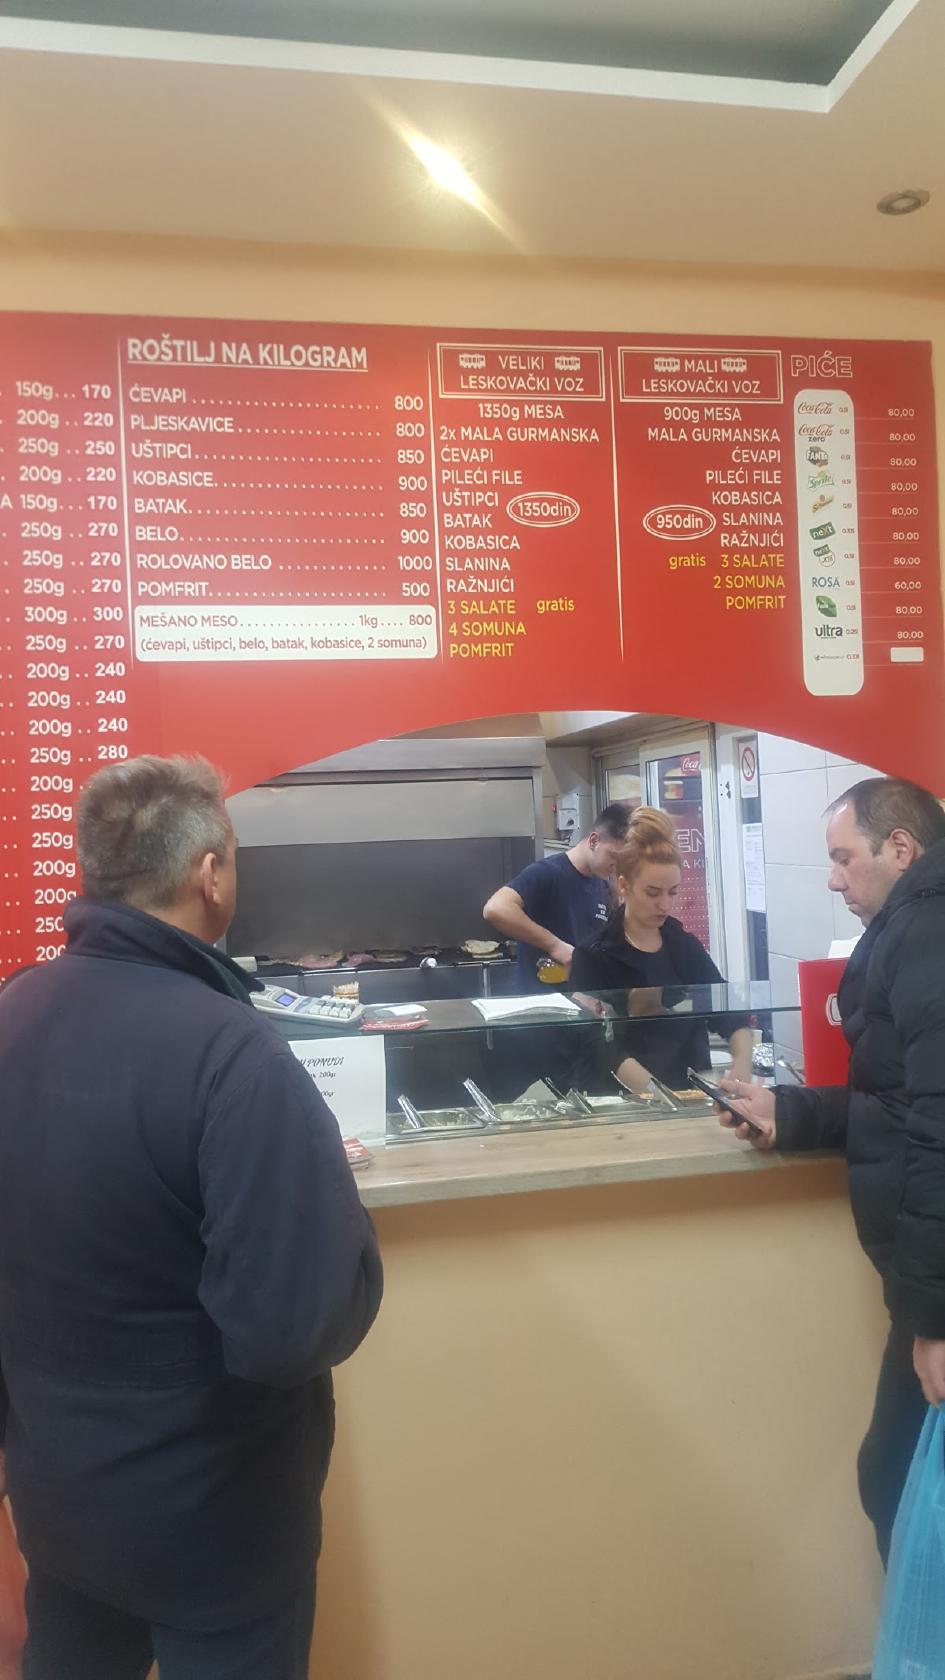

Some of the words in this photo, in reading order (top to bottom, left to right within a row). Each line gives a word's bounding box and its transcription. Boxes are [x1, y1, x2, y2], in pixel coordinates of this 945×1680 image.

[127, 333, 215, 364] ROŠTILJ
[222, 343, 253, 365] NA
[259, 345, 368, 369] KILOGRAM
[499, 355, 545, 370] VELIKI
[684, 359, 718, 373] MALI
[790, 350, 853, 378] PIĆE
[15, 381, 54, 401] 150g
[81, 385, 111, 400] 170
[460, 373, 550, 391] LESKOVAČKI
[555, 378, 584, 391] VOZ
[642, 376, 728, 393] LESKOVAČKI
[732, 380, 761, 394] VOZ
[129, 383, 187, 404] ĆEVAPI
[394, 395, 424, 411] 800
[17, 409, 59, 429] 200g
[83, 412, 114, 427] 220
[478, 403, 520, 421] 1350g
[524, 404, 565, 419] MESA
[663, 406, 700, 424] 900g
[704, 407, 743, 421] MESA
[888, 408, 915, 417] 80,00
[131, 415, 234, 433] PLJESKAVICE
[396, 422, 424, 438] 800
[440, 425, 456, 440] 2x
[461, 426, 503, 441] MALA
[507, 427, 600, 443] GURMANSKA
[648, 427, 688, 442] MALA
[691, 427, 780, 442] GURMANSKA
[18, 438, 59, 458] 250g
[85, 441, 115, 456] 250
[131, 439, 192, 459] UŠTIPCI
[397, 449, 424, 464] 850
[440, 444, 493, 462] ĆEVAPI
[731, 446, 781, 464] ĆEVAPI
[19, 466, 62, 485] 200g
[86, 467, 116, 482] 220
[133, 471, 214, 488] KOBASICE
[398, 476, 428, 491] 900
[441, 466, 487, 485] PILEĆI
[492, 470, 523, 485] FILE
[705, 467, 749, 484] PILEĆI
[753, 470, 782, 484] FILE
[20, 495, 58, 515] 150g
[87, 496, 117, 511] 170
[442, 488, 499, 506] UŠTIPCI
[518, 502, 572, 517] 1350din
[712, 491, 782, 505] KOBASICA
[134, 498, 188, 514] BATAK
[399, 502, 427, 517] 850
[891, 507, 919, 516] 80,00
[444, 514, 492, 528] BATAK
[656, 514, 704, 529] 950din
[722, 512, 783, 526] SLANINA
[20, 522, 62, 542] 250g
[88, 523, 118, 537] 270
[135, 526, 179, 542] BELO
[400, 529, 430, 544] 900
[720, 530, 784, 548] RAŽNJIĆI
[445, 535, 520, 550] KOBASICA
[22, 550, 64, 571] 250g
[90, 551, 121, 567] 270
[137, 554, 228, 570] ROLOVANO
[231, 554, 272, 570] BELO
[397, 555, 433, 571] 1000
[446, 557, 511, 571] SLANINA
[668, 552, 706, 570] gratis
[720, 554, 729, 568] 3
[733, 554, 785, 568] SALATE
[23, 578, 65, 599] 250g
[91, 579, 122, 594] 270
[137, 581, 209, 597] POMFRIT
[401, 582, 431, 598] 500
[446, 575, 515, 593] RAŽNJIĆI
[713, 575, 722, 589] 2
[725, 575, 786, 589] SOMUNA
[811, 577, 840, 588] ROSA
[894, 581, 922, 591] 60,00
[448, 600, 456, 614] 3
[460, 600, 516, 614] SALATE
[536, 596, 575, 614] gratis
[726, 595, 787, 610] POMFRIT
[24, 607, 67, 626] 300g
[92, 607, 123, 621] 300
[140, 612, 198, 627] MEŠANO
[201, 615, 238, 627] MESO
[358, 614, 378, 628] 1kg
[409, 614, 432, 626] 800
[448, 623, 458, 636] 4
[462, 621, 526, 636] SOMUNA
[815, 625, 843, 637] ultra
[25, 635, 67, 655] 250g
[94, 635, 125, 650] 270
[193, 637, 236, 652] uštipci,
[239, 637, 269, 651] belo,
[272, 637, 308, 651] batak,
[310, 637, 365, 651] kobasice,
[368, 637, 374, 648] 2
[377, 636, 427, 649] somuna)
[450, 643, 514, 658] POMFRIT
[26, 662, 69, 681] 200g
[95, 662, 126, 677] 240
[27, 691, 71, 710] 200g
[95, 690, 126, 704] 240
[28, 719, 72, 738] 200g
[97, 718, 128, 733] 240
[30, 747, 72, 766] 250g
[97, 745, 128, 760] 280
[30, 776, 74, 795] 200g
[31, 804, 73, 822] 250g
[31, 832, 74, 850] 250g
[32, 860, 76, 879] 200g
